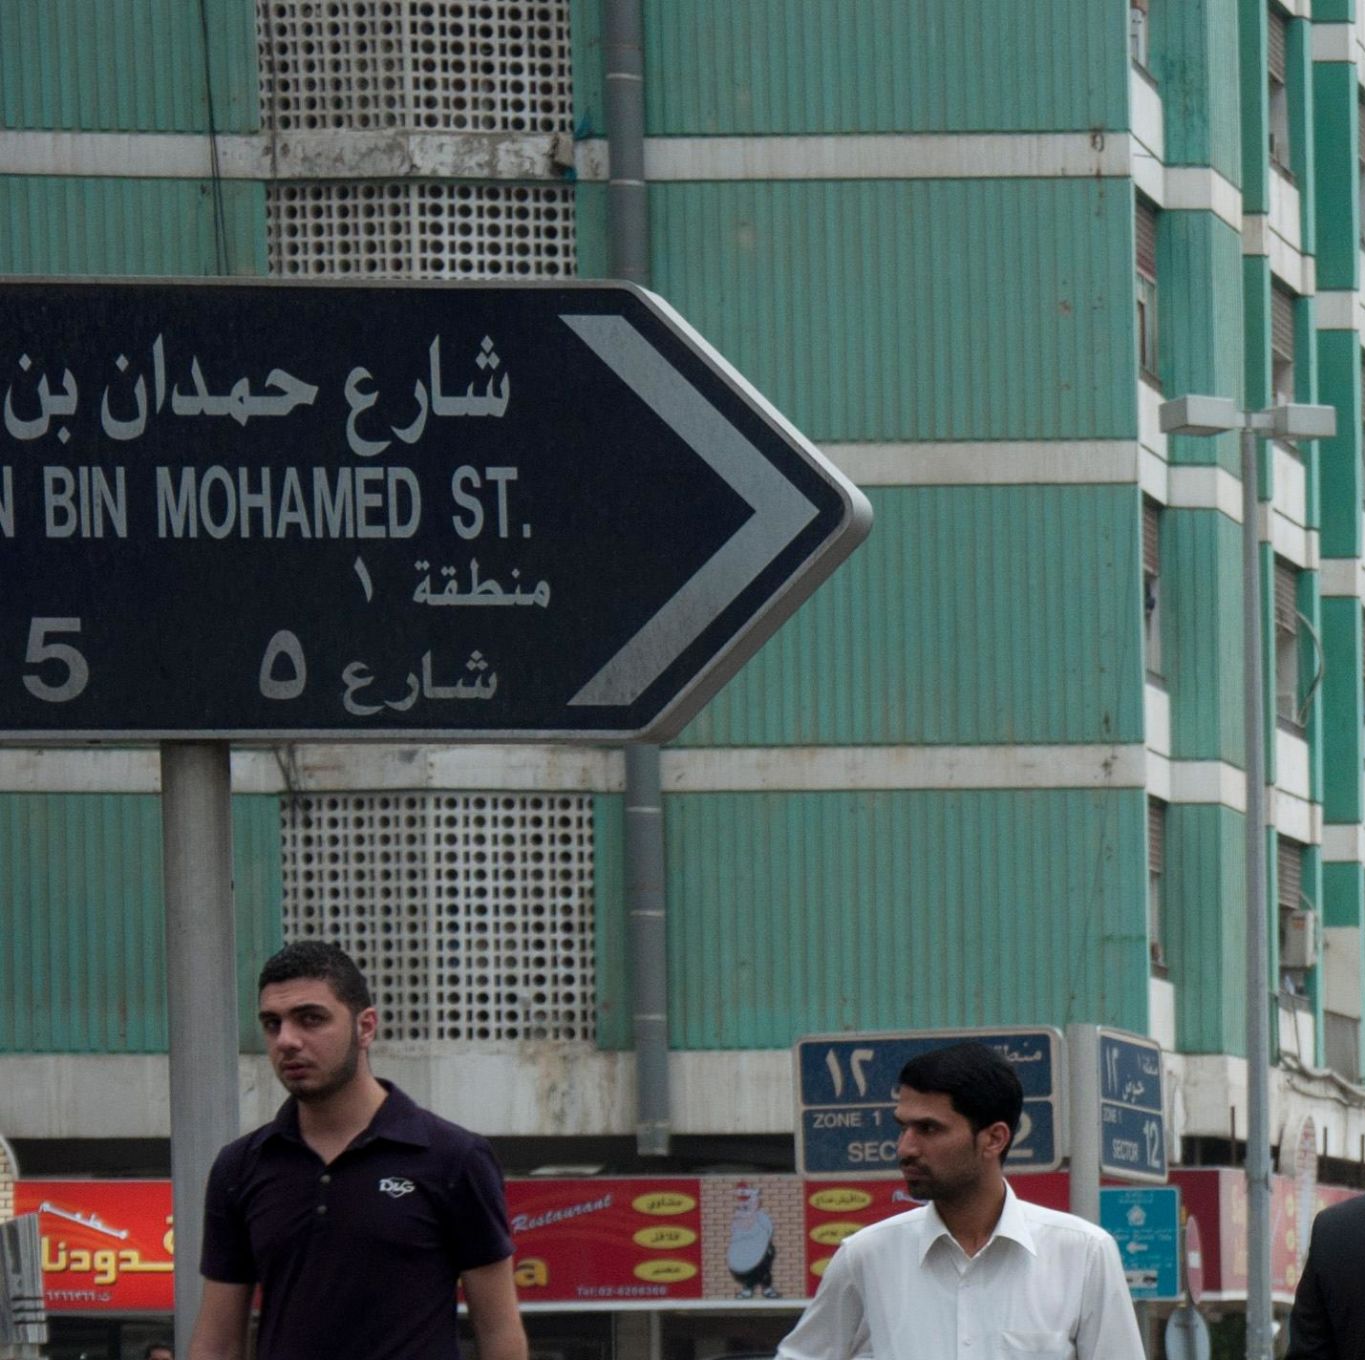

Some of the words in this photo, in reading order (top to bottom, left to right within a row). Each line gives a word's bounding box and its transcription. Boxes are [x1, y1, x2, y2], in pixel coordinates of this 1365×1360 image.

[4, 353, 78, 445] بن
[101, 332, 319, 441] حمدان
[344, 333, 511, 457] شارع
[43, 465, 128, 539] BIN
[156, 464, 422, 540] MOHAMED
[451, 464, 532, 540] ST.
[353, 556, 374, 603] ١
[413, 557, 551, 608] منطقة
[22, 616, 90, 703] 5
[259, 629, 308, 700] ٥
[341, 649, 499, 717] شارع
[812, 1111, 862, 1129] ZONE
[873, 1110, 882, 1127] 1
[847, 1139, 898, 1163] SEC
[1112, 1138, 1139, 1163] SECTOR
[1143, 1120, 1162, 1169] 12
[511, 1192, 614, 1234] Restaurant
